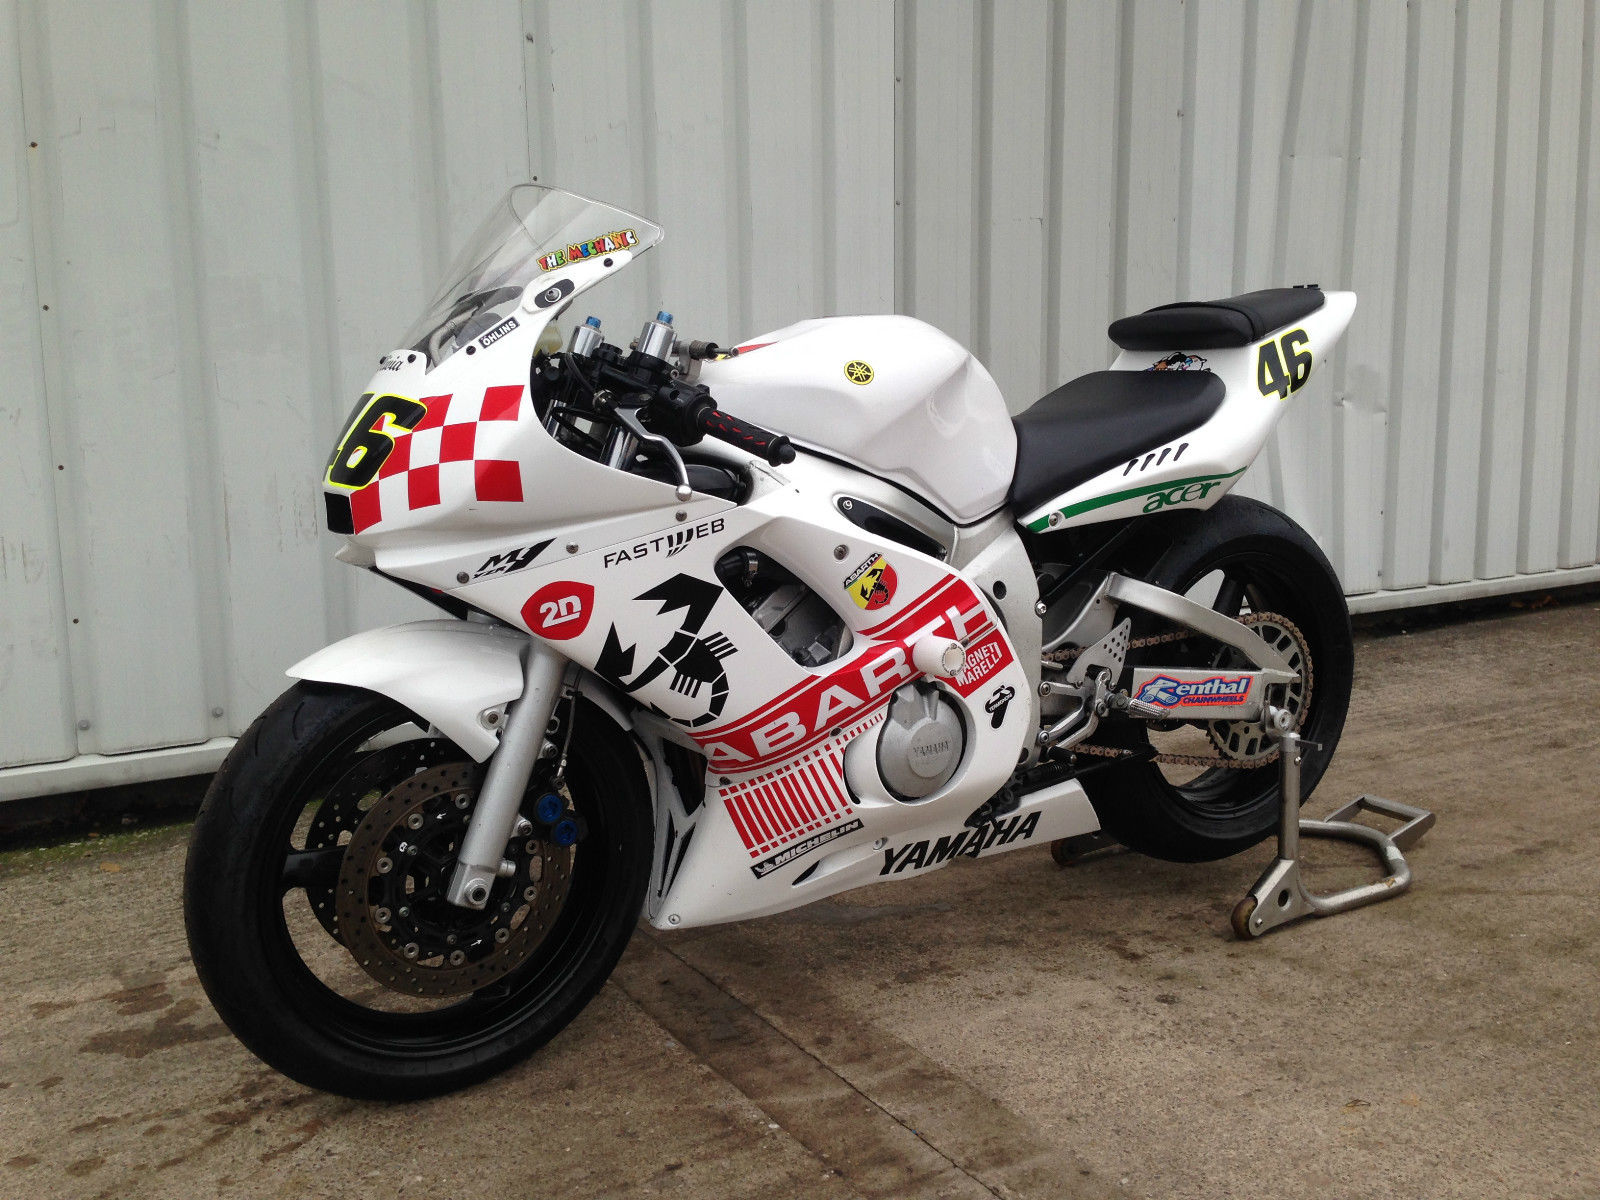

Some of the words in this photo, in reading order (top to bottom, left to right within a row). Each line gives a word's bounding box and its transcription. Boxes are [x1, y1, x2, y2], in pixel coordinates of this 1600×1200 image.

[537, 251, 566, 271] THE
[568, 230, 638, 262] MECHANIC
[1257, 328, 1312, 400] 46
[1143, 482, 1221, 513] acer
[603, 518, 724, 568] FASTWEB
[845, 552, 881, 587] ABARTH
[955, 646, 1003, 687] MARELLI
[963, 641, 1000, 673] AGNETI
[1141, 679, 1248, 704] Renthal
[774, 820, 859, 866] MICHELIN
[879, 811, 1042, 876] YAMAHA
